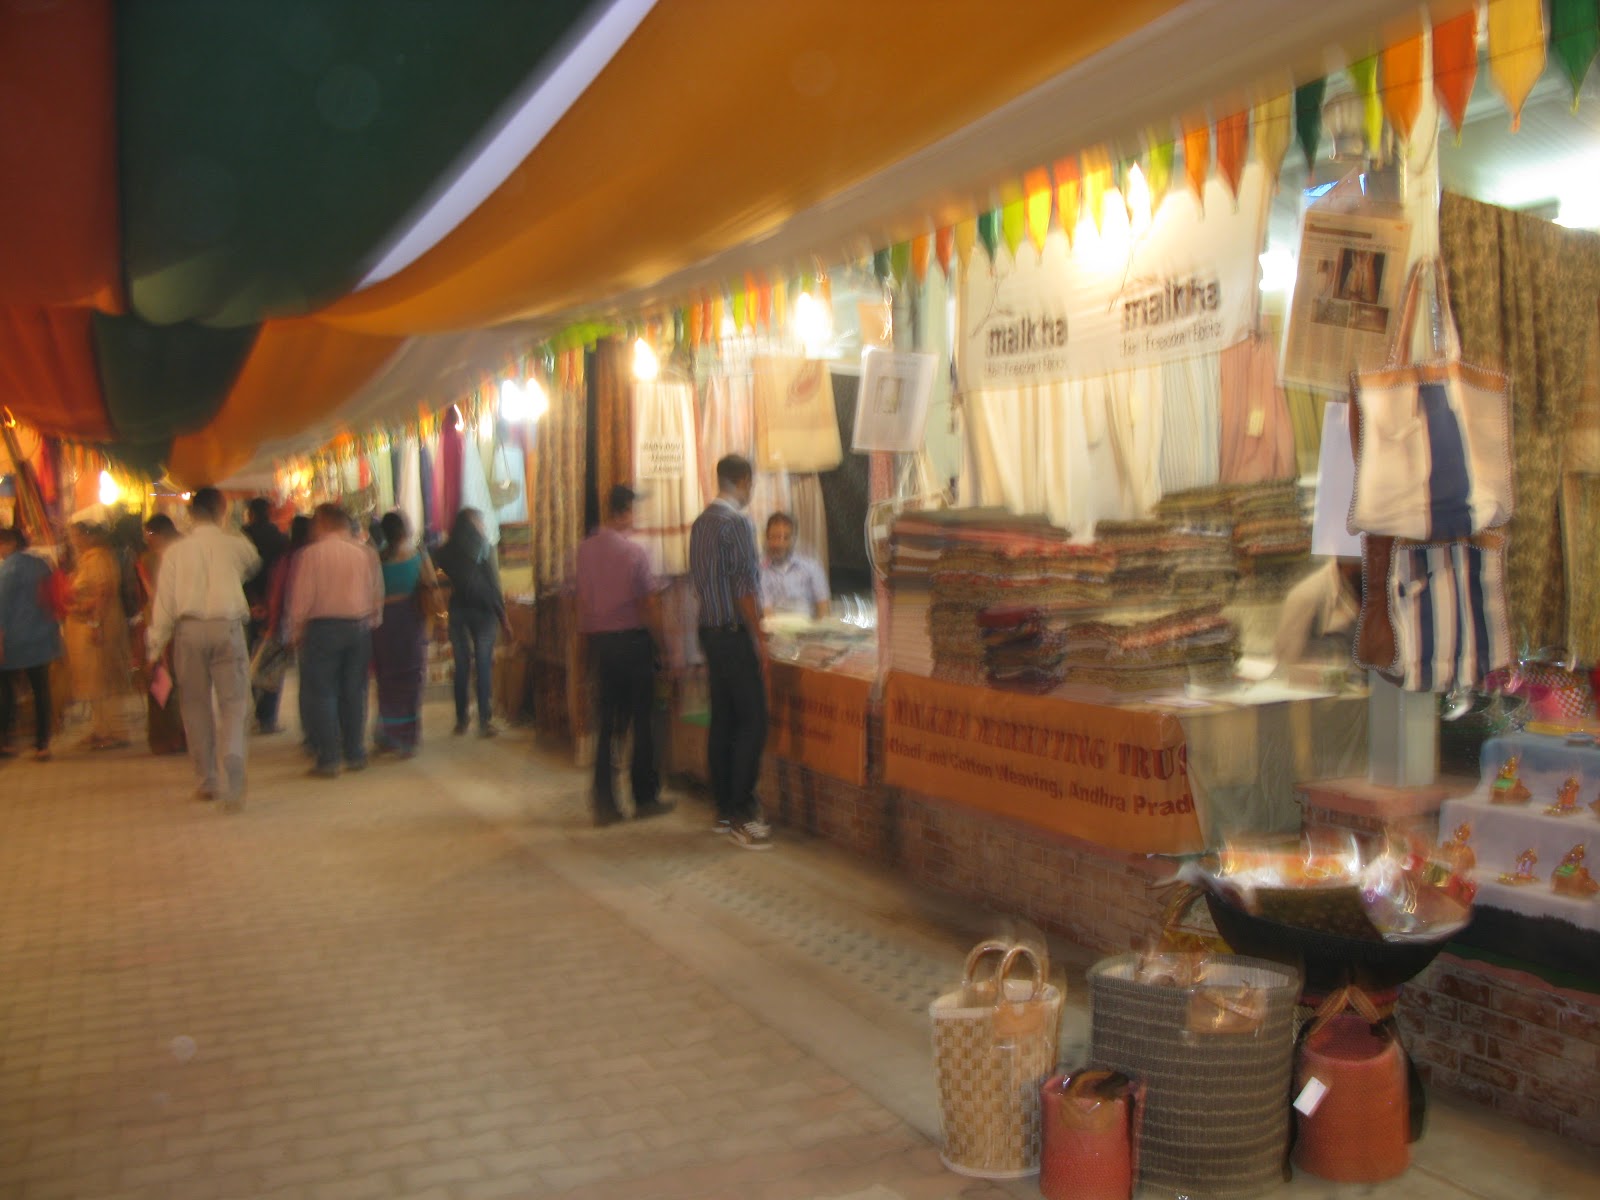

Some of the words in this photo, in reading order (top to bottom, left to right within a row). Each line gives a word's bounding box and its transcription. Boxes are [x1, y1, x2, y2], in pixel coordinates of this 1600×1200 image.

[1121, 279, 1220, 331] malkha
[987, 314, 1069, 356] malkha
[950, 753, 993, 779] Cotton
[1070, 781, 1127, 813] Andhra
